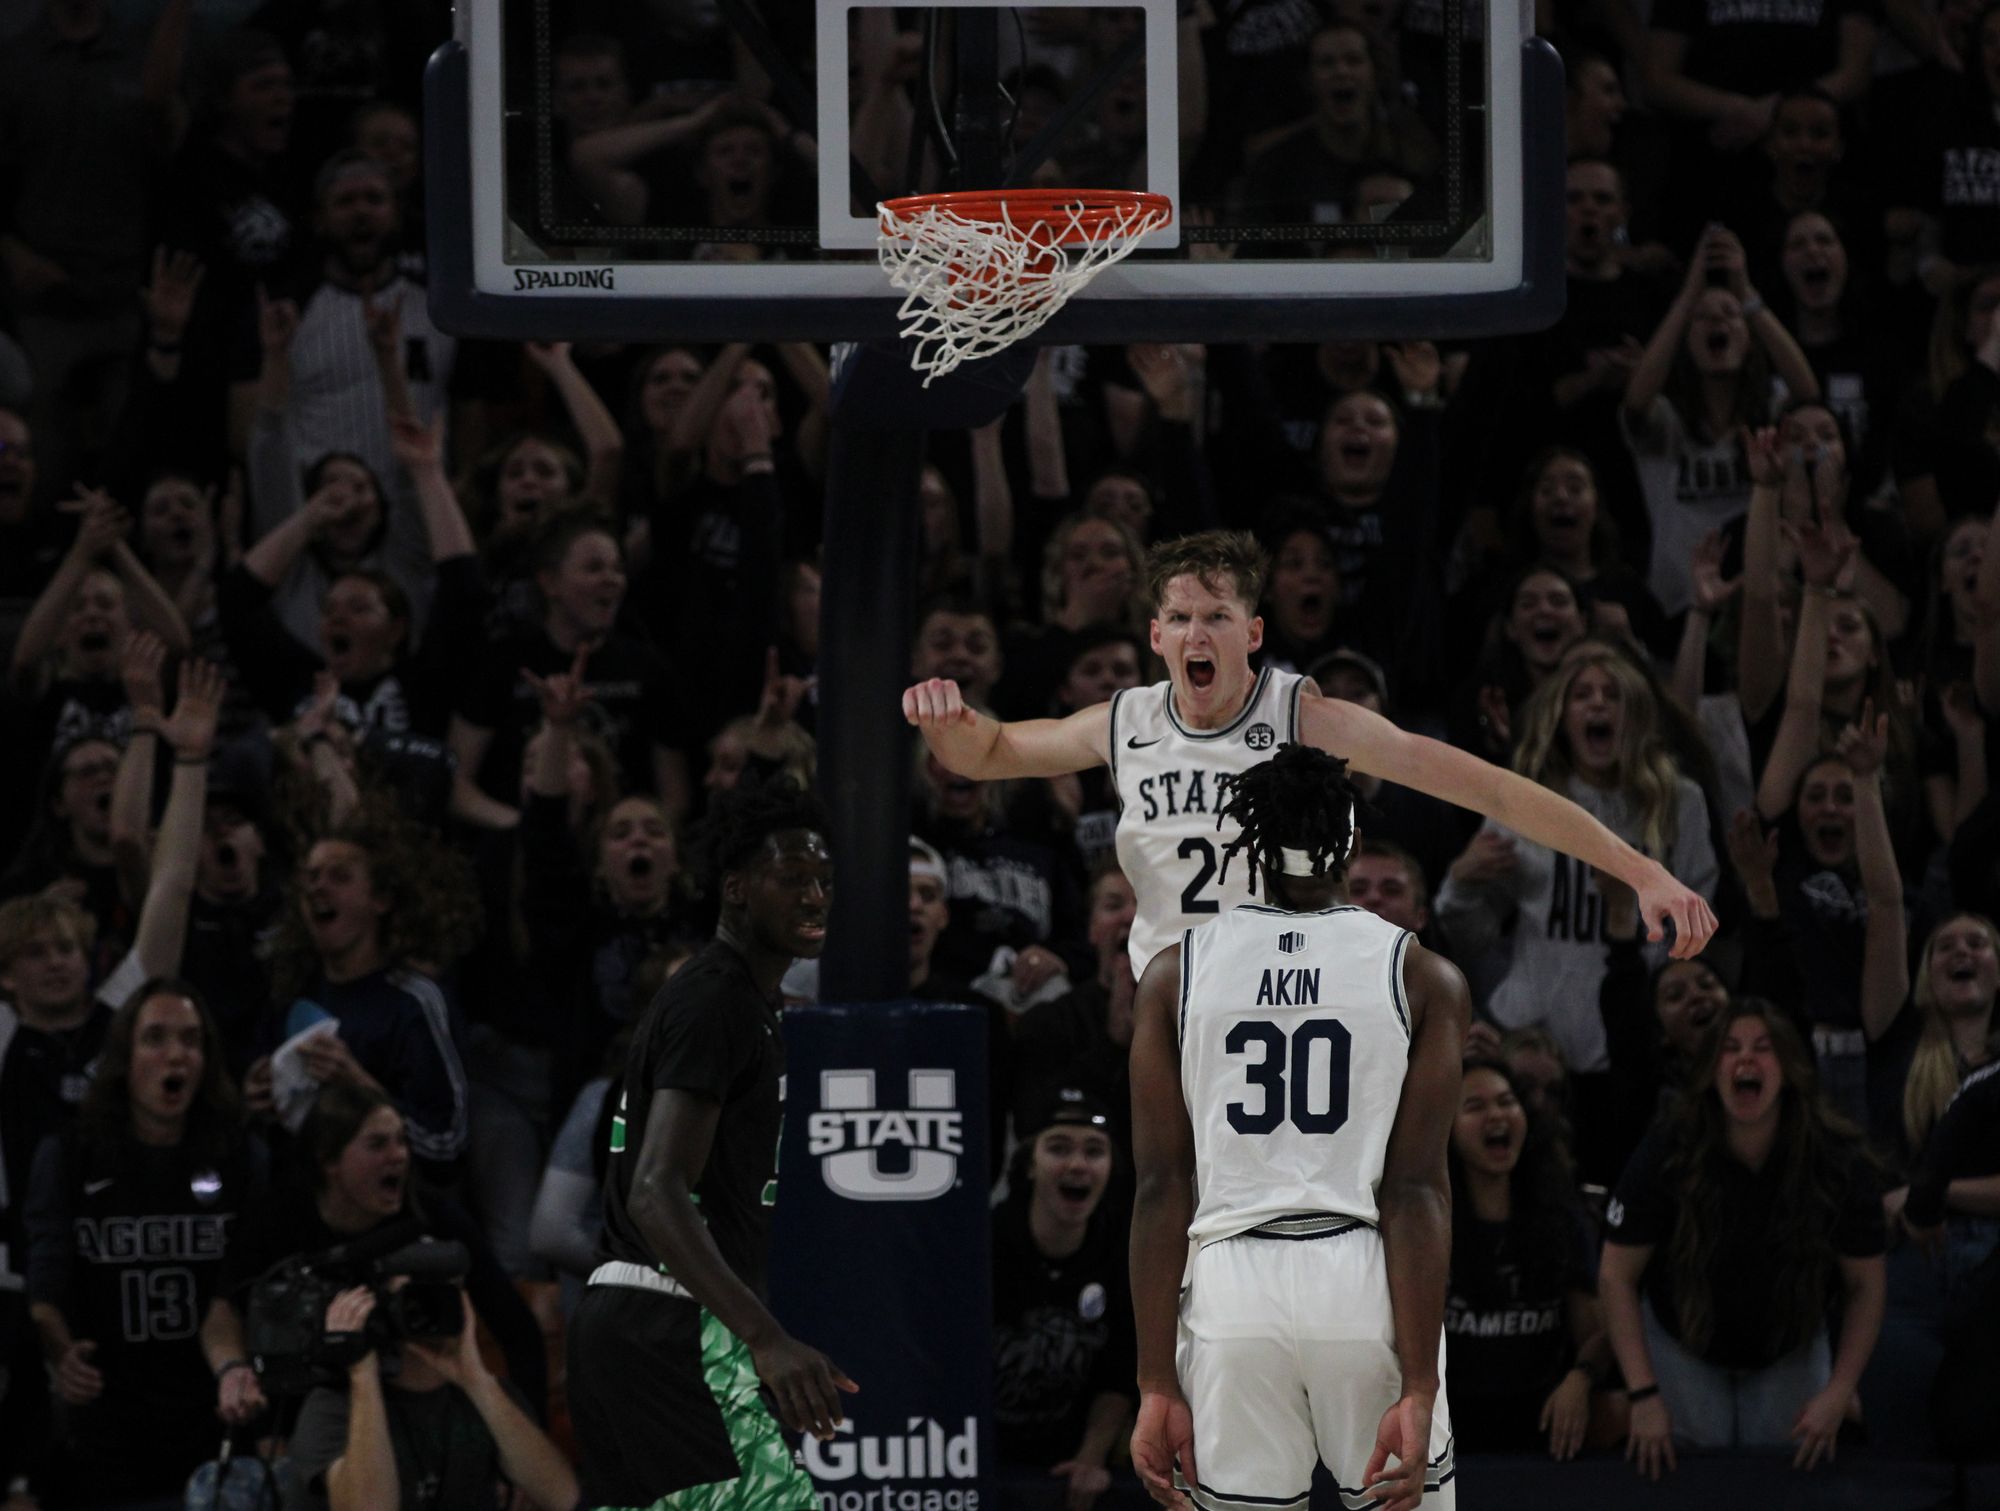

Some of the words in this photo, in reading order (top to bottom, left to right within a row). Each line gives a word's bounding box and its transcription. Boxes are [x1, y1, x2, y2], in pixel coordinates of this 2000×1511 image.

[514, 268, 614, 291] SPALDING
[1248, 733, 1272, 748] 33
[1139, 769, 1240, 821] STAT
[1177, 837, 1220, 914] 2
[1256, 968, 1320, 1006] AKIN
[1225, 1018, 1352, 1135] 30
[807, 1111, 965, 1157] STATE
[120, 1266, 200, 1343] 13
[1446, 1309, 1560, 1337] GAMEDA
[802, 1416, 979, 1481] Guild
